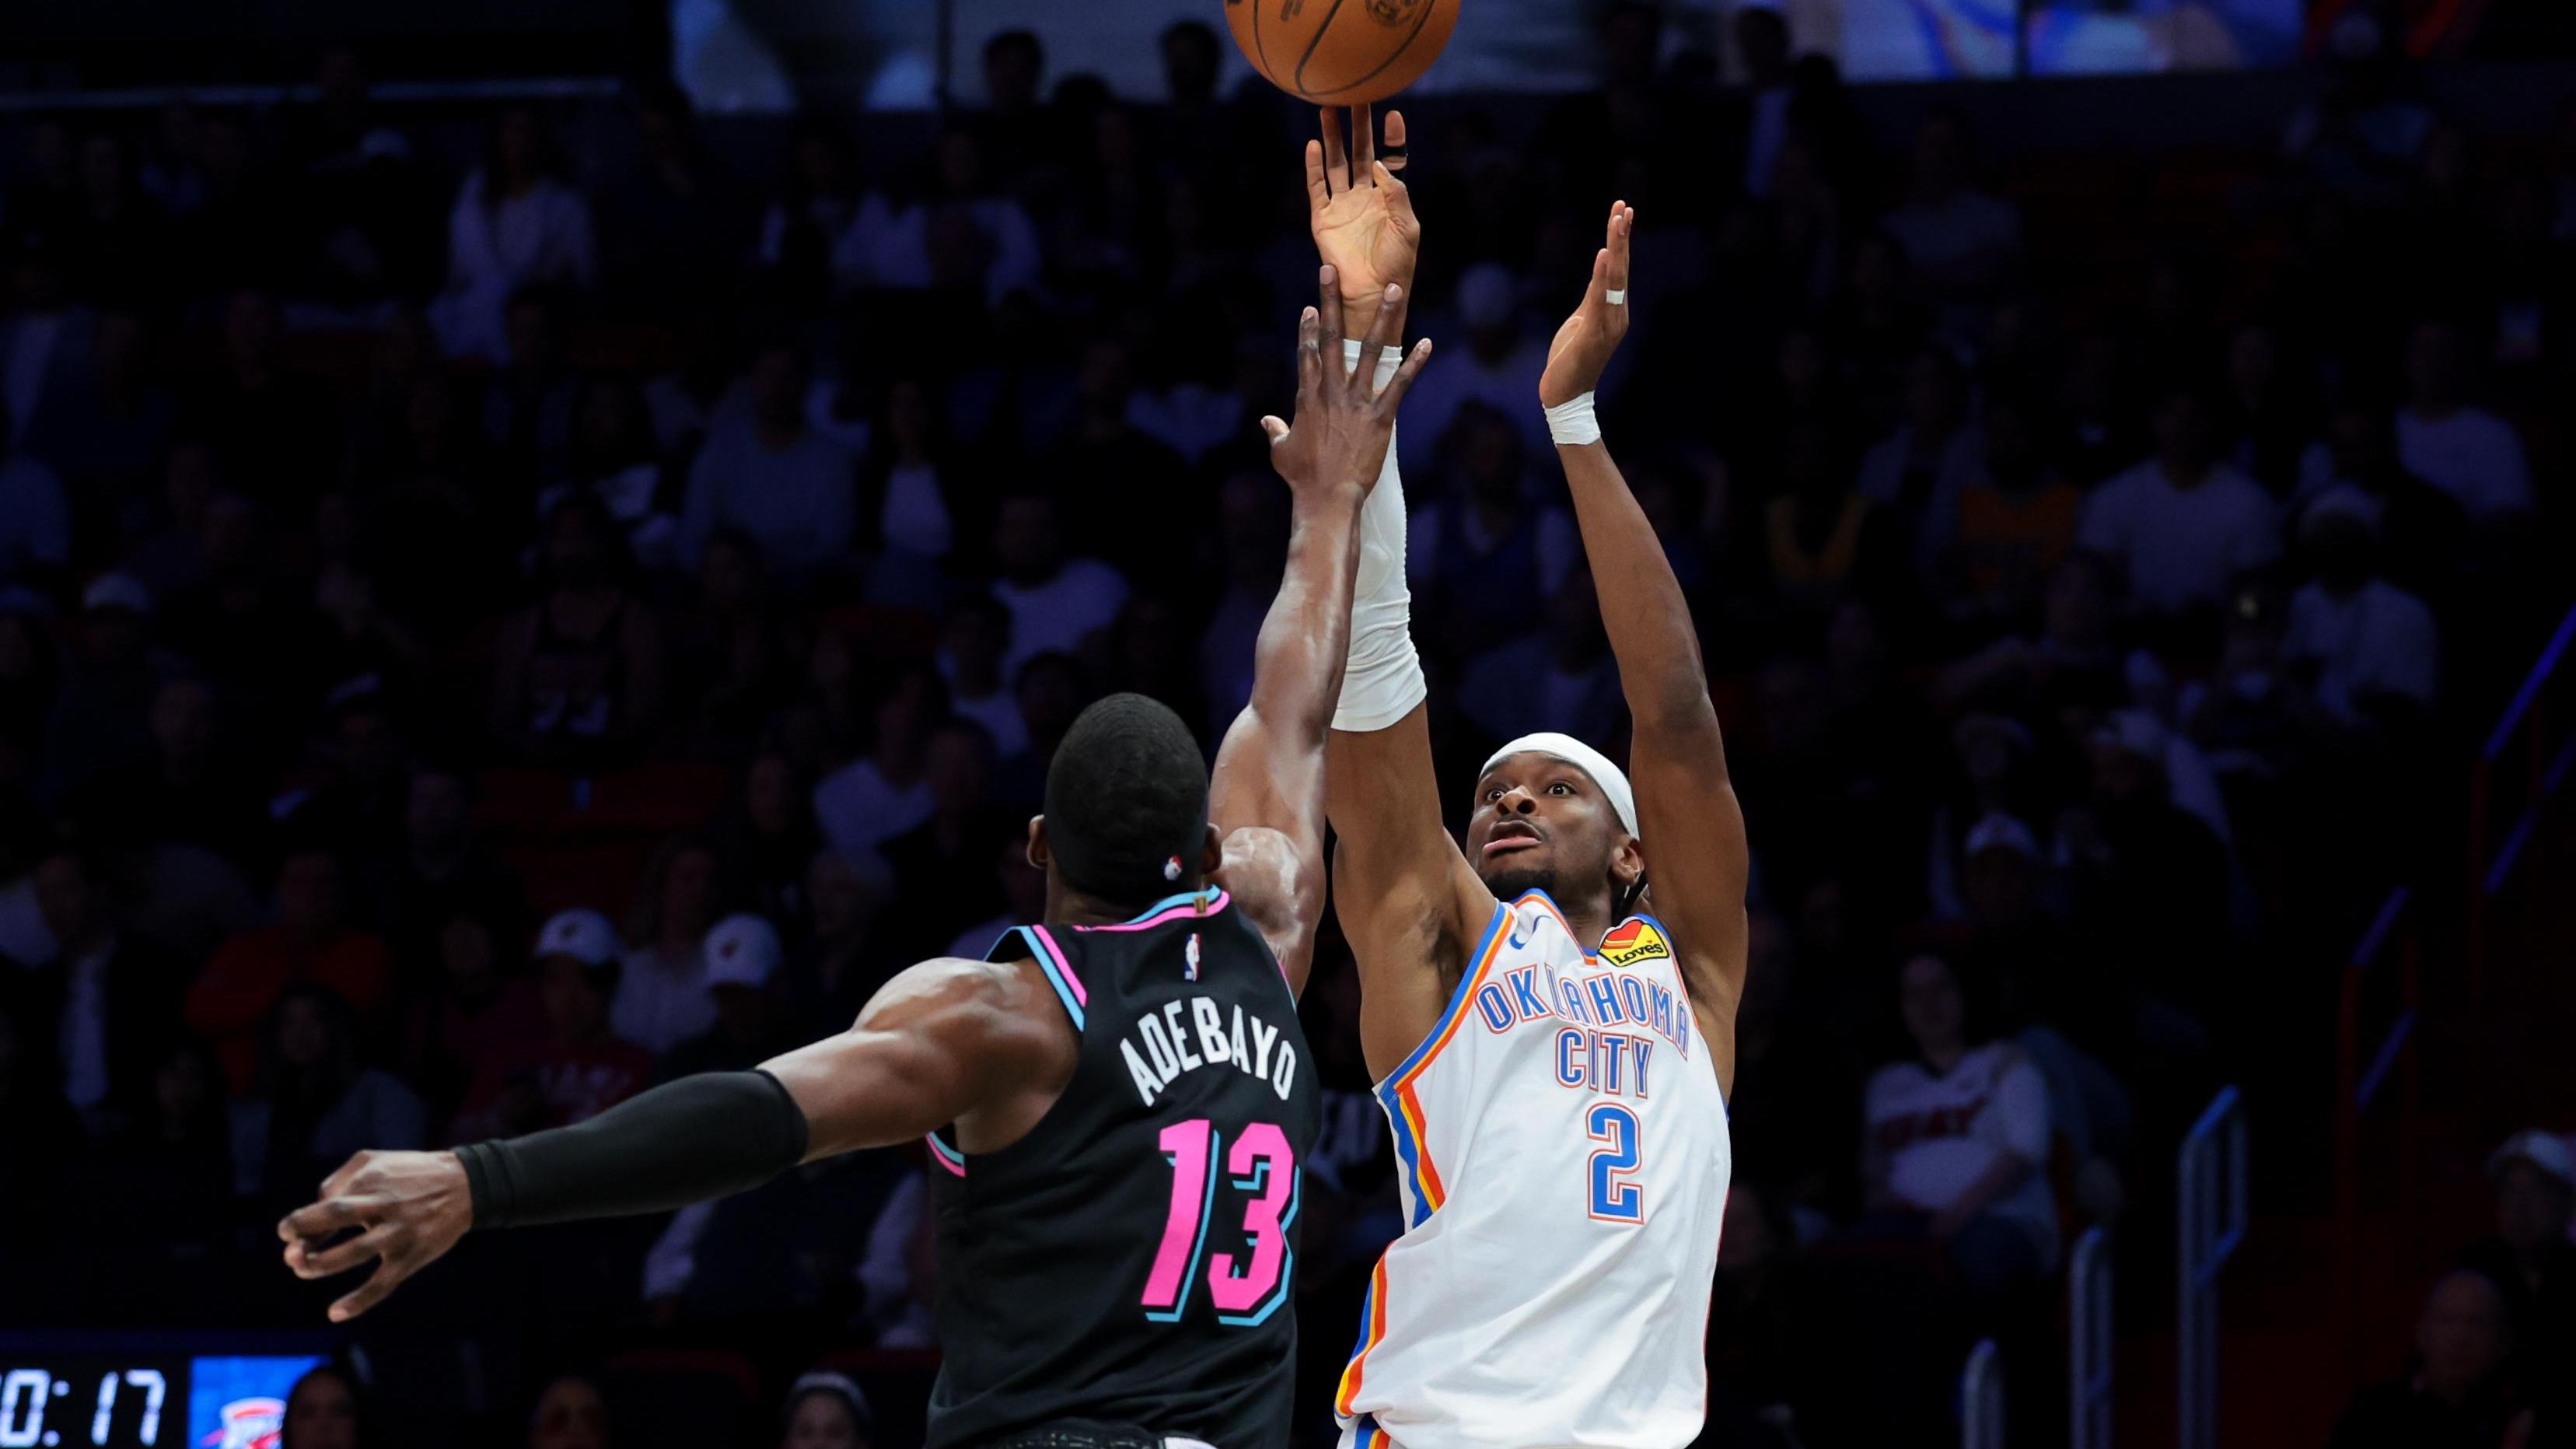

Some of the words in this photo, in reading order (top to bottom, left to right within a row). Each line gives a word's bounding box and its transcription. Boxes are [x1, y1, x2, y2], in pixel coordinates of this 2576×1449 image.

[1120, 996, 1296, 1107] ADEBAYO
[1475, 964, 1689, 1060] OKLAHOMA
[1555, 1027, 1653, 1099] CITY
[1585, 1102, 1645, 1225] 2
[1141, 1118, 1301, 1327] 13
[0, 1367, 167, 1448] 0:17
